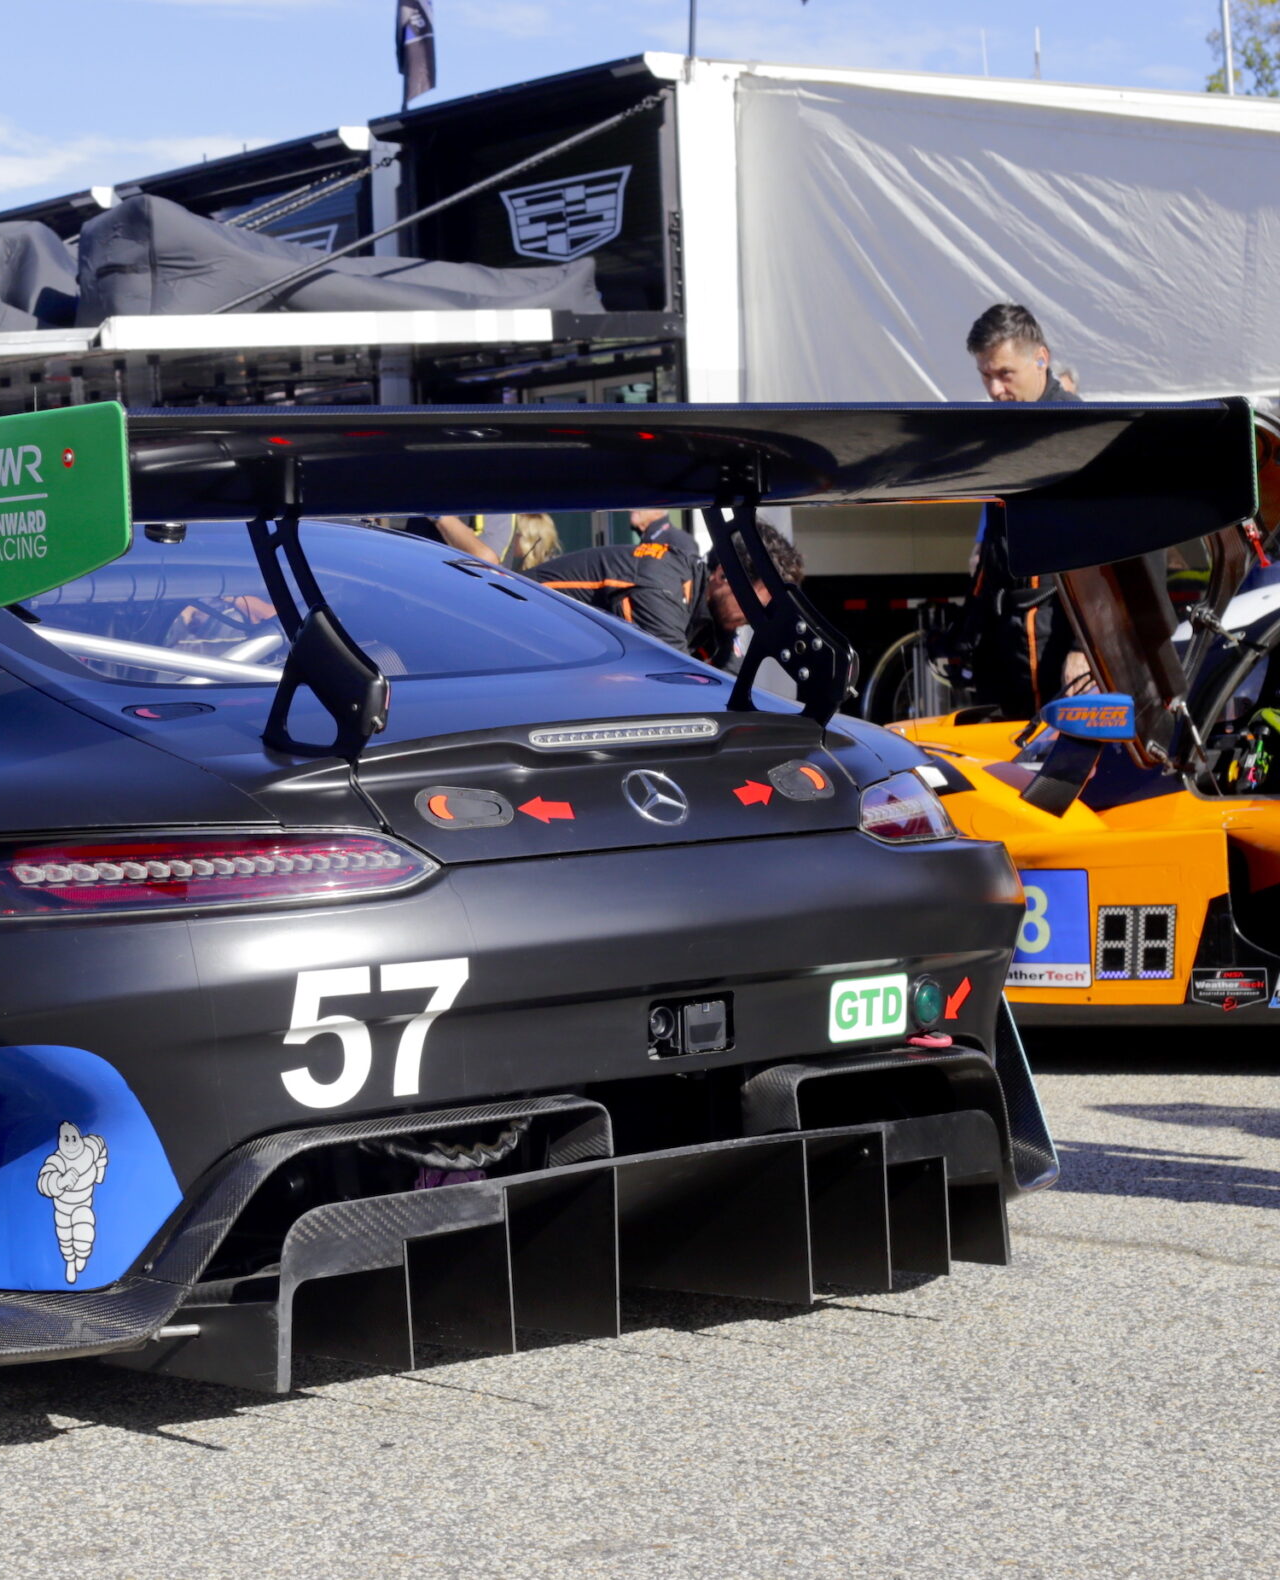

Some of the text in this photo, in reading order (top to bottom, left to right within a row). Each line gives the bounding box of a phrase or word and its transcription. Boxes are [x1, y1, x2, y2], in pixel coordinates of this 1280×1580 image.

[1057, 706, 1130, 721] TOWER
[1016, 885, 1051, 954] 8
[1195, 980, 1264, 989] WeatherTech
[835, 986, 903, 1030] GTD
[280, 957, 470, 1109] 57
